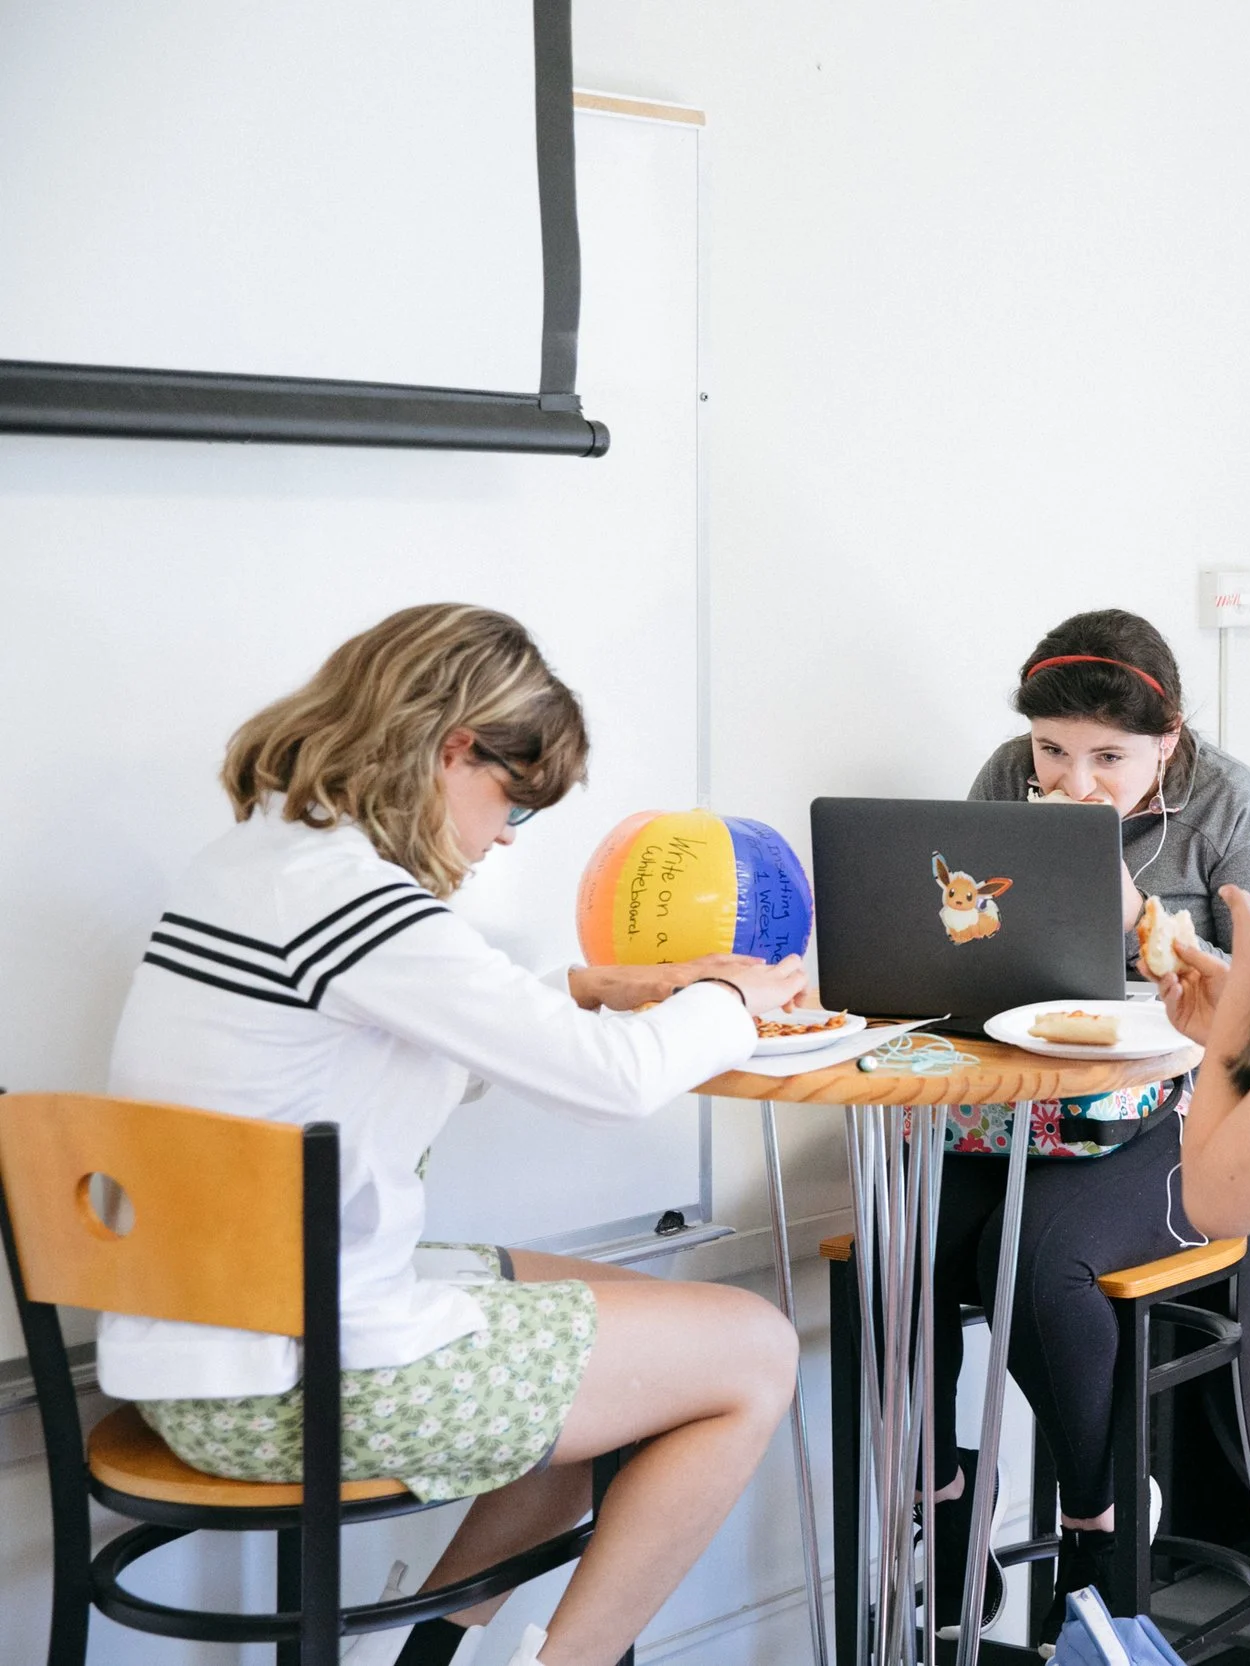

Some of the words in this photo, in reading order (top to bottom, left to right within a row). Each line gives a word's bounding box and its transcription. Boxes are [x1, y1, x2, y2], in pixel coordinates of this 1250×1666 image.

[660, 835, 707, 884] Write
[655, 889, 674, 919] on
[656, 931, 669, 949] a
